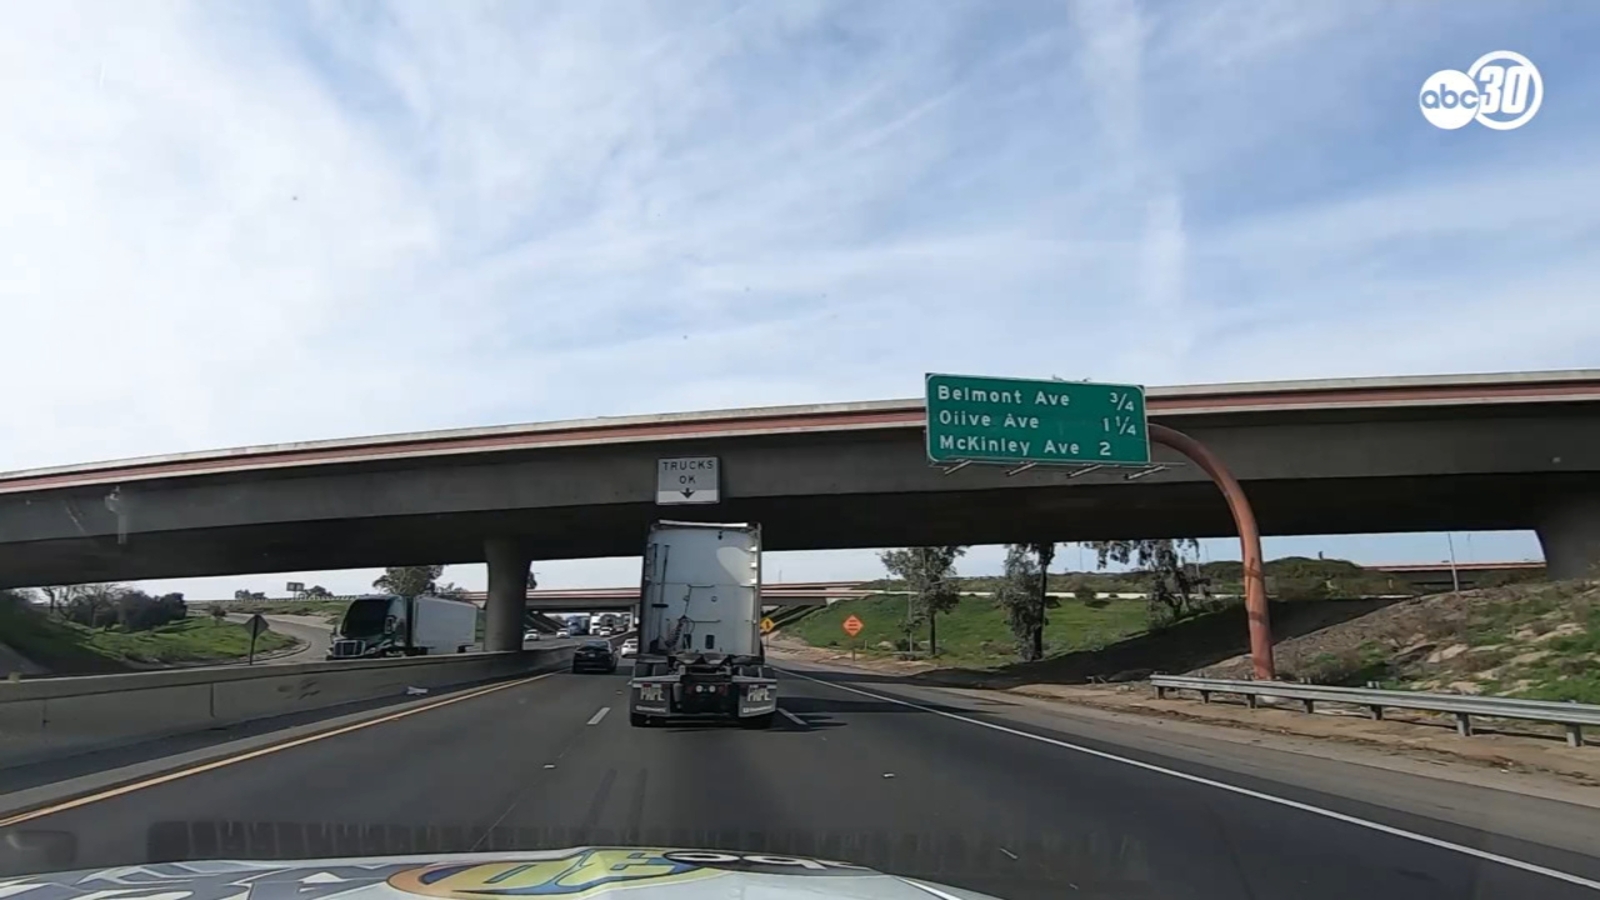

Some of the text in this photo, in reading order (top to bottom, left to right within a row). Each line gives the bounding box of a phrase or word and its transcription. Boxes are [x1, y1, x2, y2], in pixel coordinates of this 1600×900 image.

[937, 385, 1022, 404] Belmont
[1035, 391, 1070, 406] Ave
[1004, 414, 1040, 428] Ave
[940, 435, 1111, 456] McKinley Ave 2
[662, 460, 714, 470] TRUCKS
[679, 475, 696, 484] OK
